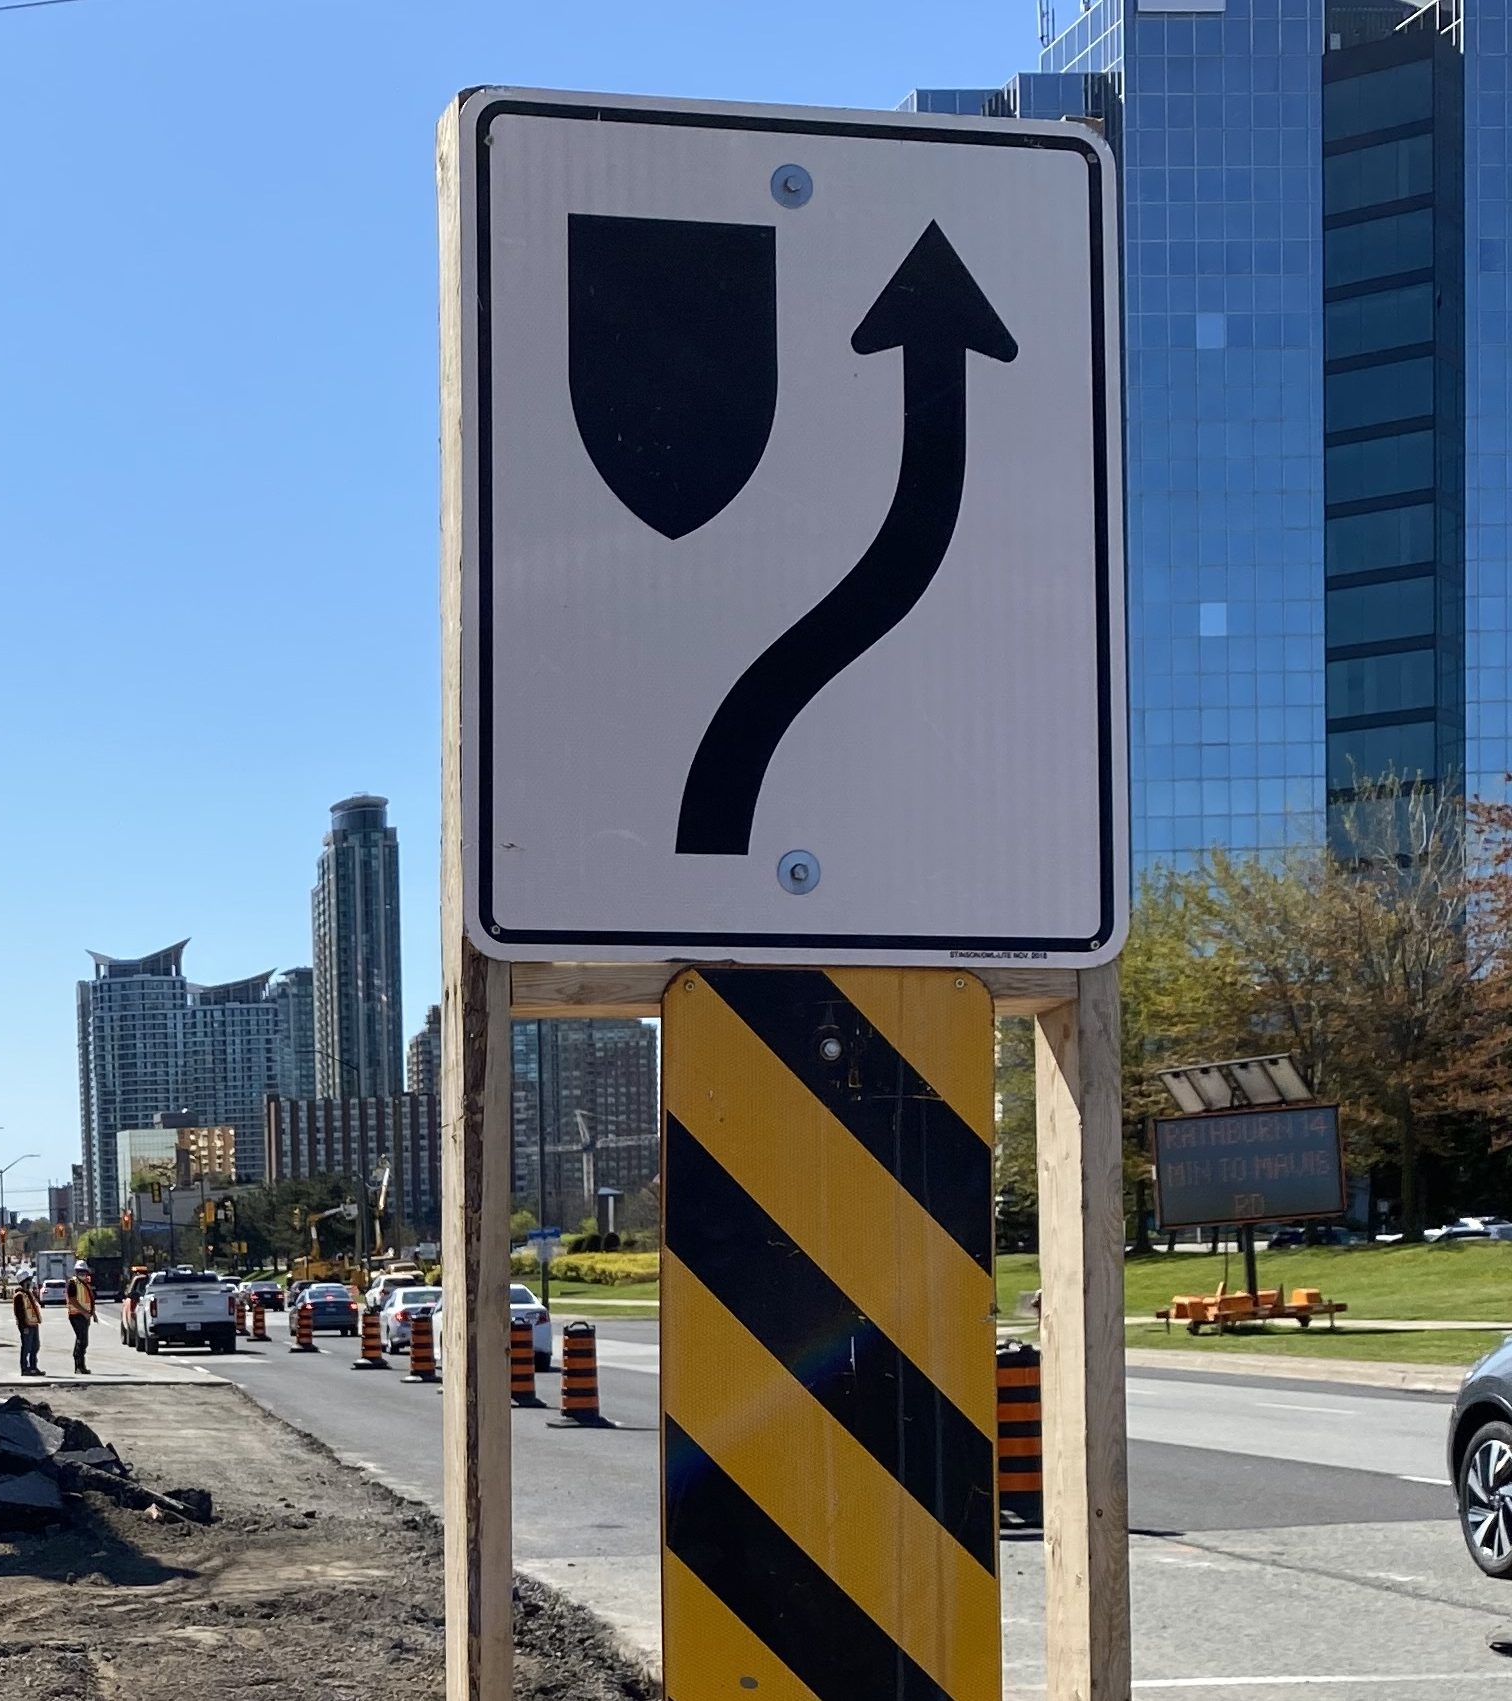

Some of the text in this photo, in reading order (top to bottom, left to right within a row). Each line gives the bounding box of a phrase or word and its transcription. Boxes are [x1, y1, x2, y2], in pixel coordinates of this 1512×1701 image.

[1167, 1159, 1211, 1186] MIN
[1220, 1156, 1246, 1182] TO
[1235, 1193, 1265, 1217] RD
